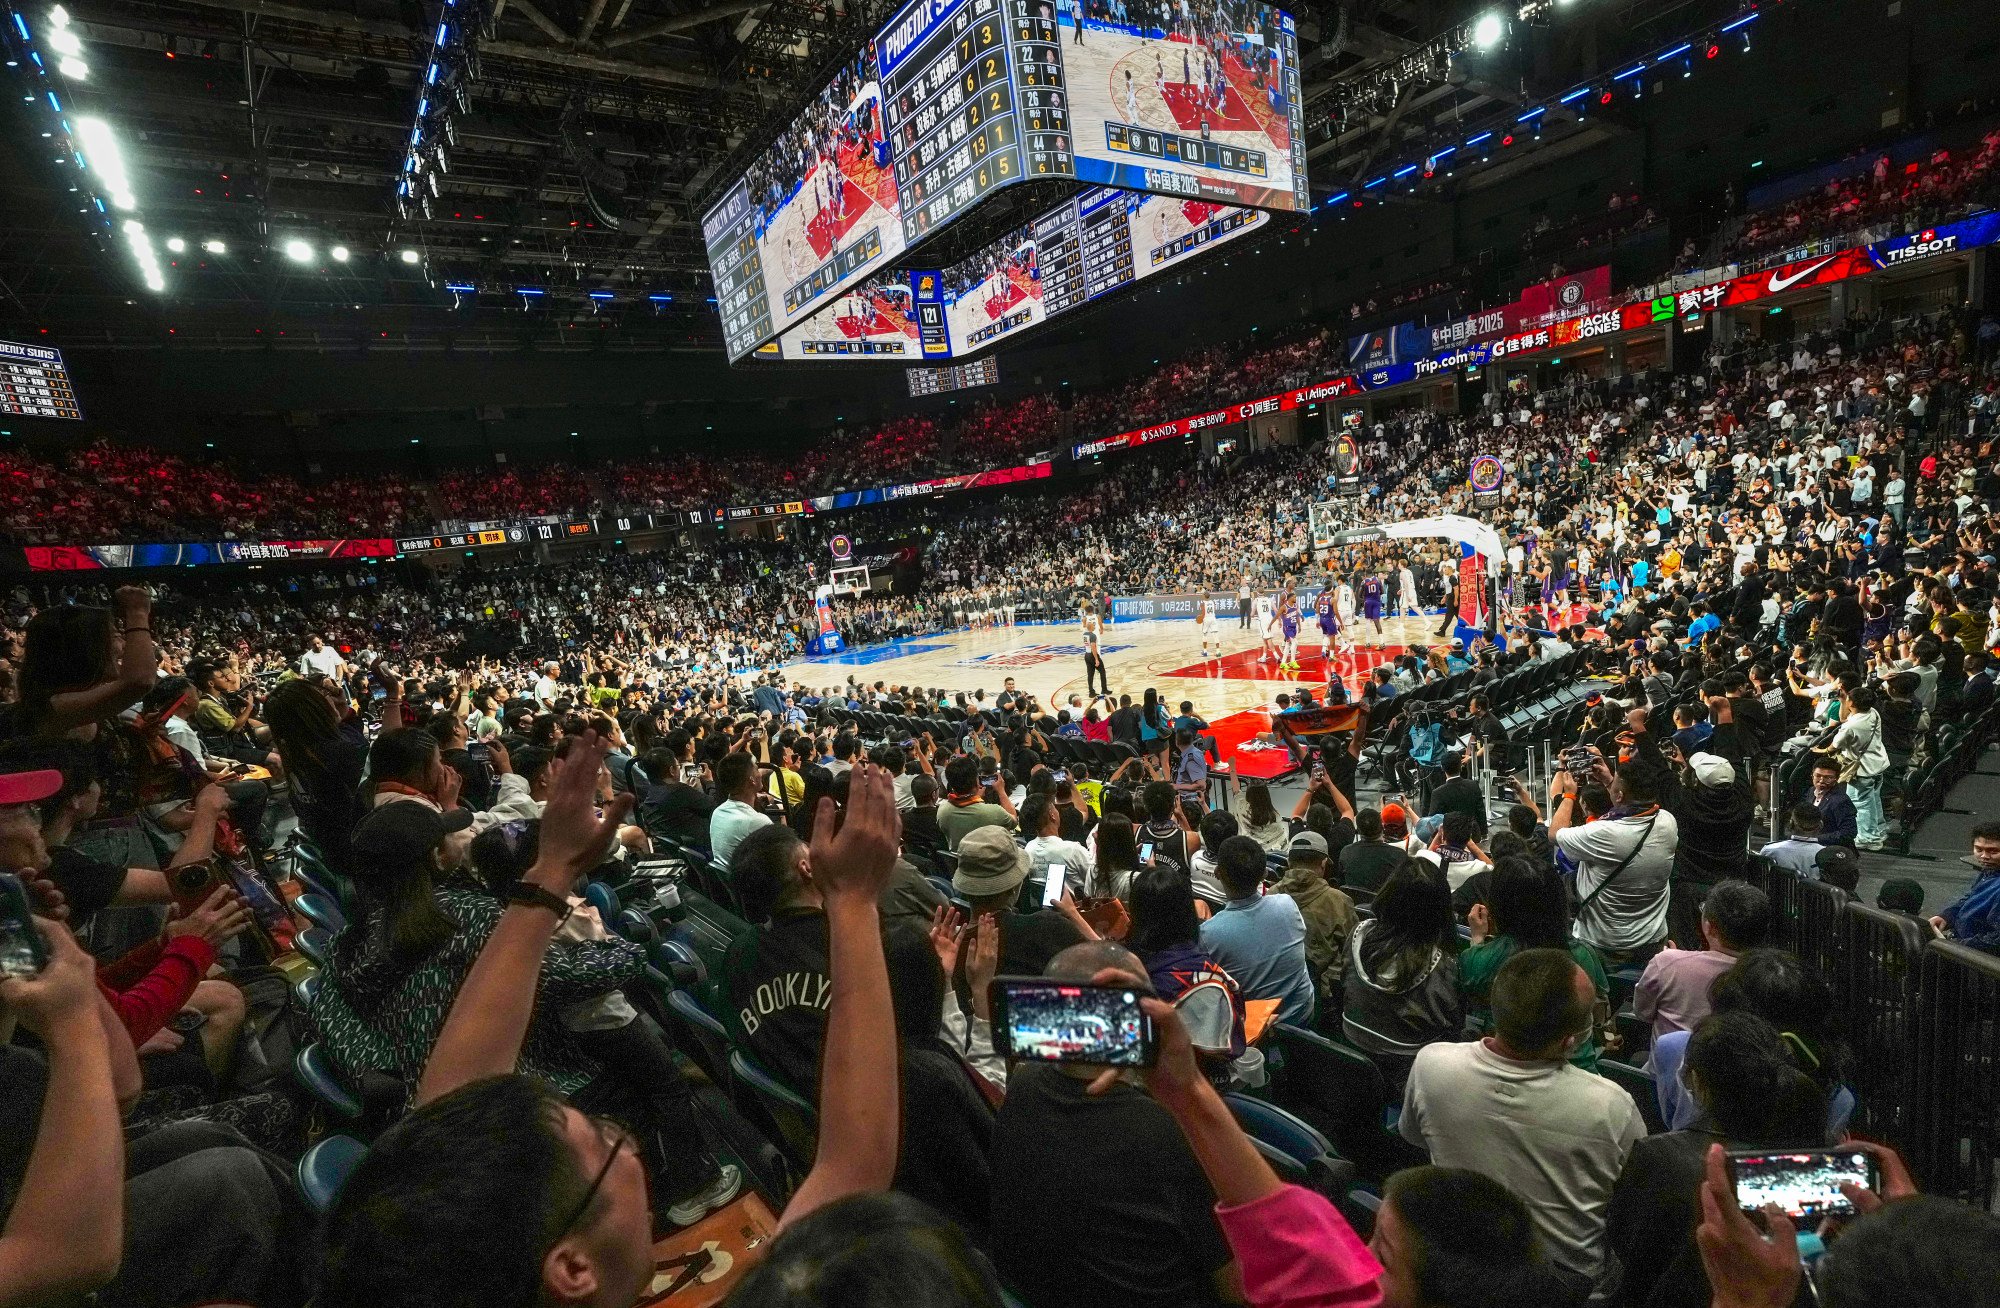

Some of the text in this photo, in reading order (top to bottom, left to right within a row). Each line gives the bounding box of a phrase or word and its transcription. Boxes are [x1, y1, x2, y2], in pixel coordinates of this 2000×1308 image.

[1016, 0, 1028, 17] 12
[885, 0, 934, 65] PHOENIX
[1022, 29, 1051, 41] 0 3
[1021, 46, 1034, 62] 22
[889, 104, 898, 126] 10
[962, 41, 969, 60] 7
[982, 25, 992, 44] 3
[1027, 75, 1056, 86] 6 1
[893, 132, 903, 155] 20
[967, 74, 974, 92] 6
[986, 59, 997, 78] 2
[1027, 91, 1040, 107] 26
[1033, 119, 1061, 130] 0 1
[898, 92, 1001, 182] 21 2 2
[1033, 135, 1045, 151] 44
[1148, 136, 1159, 153] 121
[1186, 143, 1198, 161] 0.0
[1223, 150, 1233, 166] 121
[902, 189, 912, 210] 23
[973, 136, 986, 157] 13
[995, 125, 1003, 142] 1
[1039, 163, 1067, 173] 6 1
[1151, 169, 1200, 195] 中国赛2025
[727, 193, 742, 219] NETS
[906, 217, 916, 238] 25
[979, 169, 987, 187] 6
[999, 157, 1009, 175] 5
[1081, 192, 1103, 212] PHOENIX
[1036, 208, 1074, 236] BROOKLYN NETS
[1113, 218, 1118, 226] 7
[741, 243, 745, 255] 7
[749, 235, 754, 247] 4
[1911, 234, 1920, 243] T
[1887, 236, 1957, 261] TISSOT
[1903, 253, 1926, 263] WATCHES
[1927, 250, 1943, 258] SINCE
[752, 257, 758, 269] 3
[1118, 259, 1124, 267] 13
[748, 279, 761, 296] 6 1
[761, 300, 765, 310] 1
[1679, 284, 1726, 313] 蒙牛
[923, 307, 938, 323] 121
[1578, 310, 1621, 329] JACK&
[756, 320, 769, 337] 6 1
[1440, 311, 1504, 343] 中国赛2025
[1578, 320, 1621, 339] JONES
[1506, 331, 1549, 353] 佳得乐
[27, 348, 54, 359] SUNS
[1414, 352, 1468, 374] Trip.com
[1372, 371, 1388, 381] aws
[1308, 381, 1346, 400] Alipay+
[1254, 398, 1279, 415] 阿里云
[1188, 411, 1226, 430] 淘宝88VIP
[1148, 423, 1177, 440] SANDS
[898, 483, 933, 497] 中国赛2025
[689, 511, 702, 524] 121
[753, 508, 758, 516] 1
[777, 505, 782, 513] 5
[617, 518, 631, 531] 0.0
[402, 539, 432, 550] 剩余暂停
[433, 538, 441, 548] 0
[467, 535, 475, 545] 5
[485, 533, 500, 543] 罚球
[537, 525, 553, 540] 121
[240, 545, 289, 558] 中国赛2025
[1368, 584, 1376, 593] 10
[1120, 601, 1154, 615] TIP-OFF 2025
[1320, 606, 1329, 614] 23
[740, 972, 832, 1036] BOOKLY
